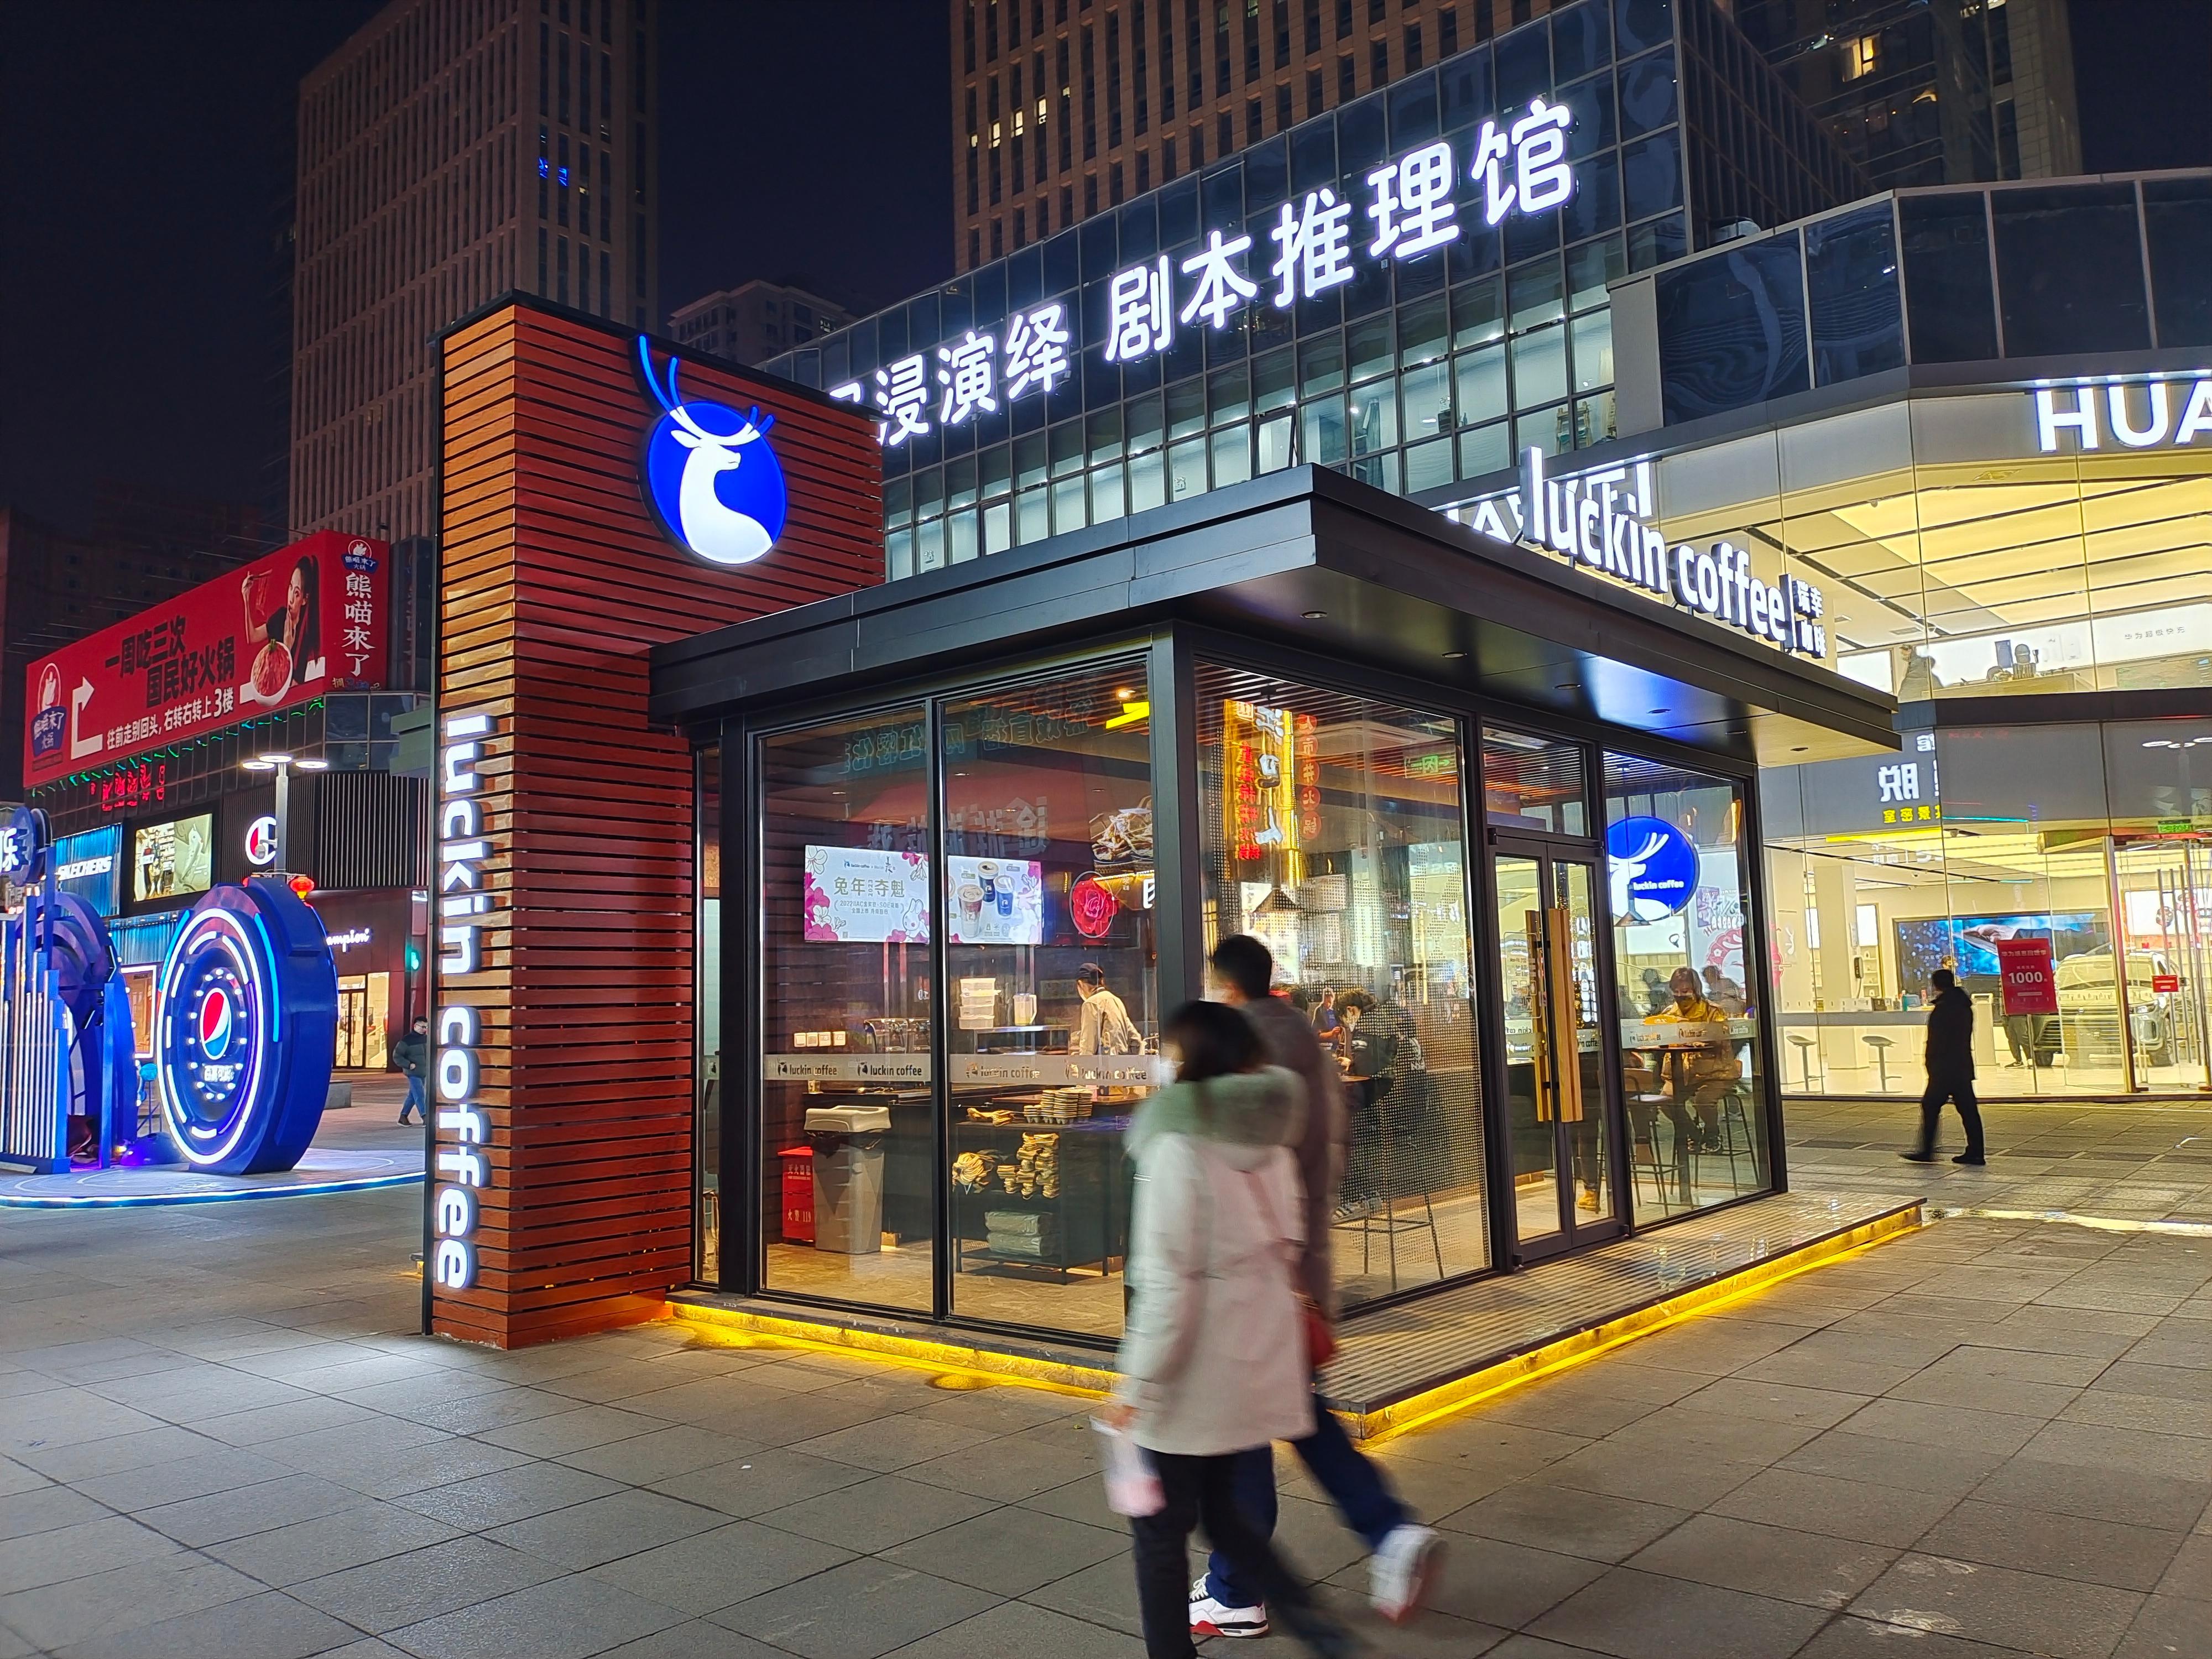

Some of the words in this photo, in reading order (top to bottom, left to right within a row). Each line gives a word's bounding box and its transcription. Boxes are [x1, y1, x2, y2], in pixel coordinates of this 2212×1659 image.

[830, 304, 1070, 446] 浸演绎
[1104, 98, 1573, 363] 剧本推理馆
[1521, 446, 1668, 594] luckin
[1673, 542, 1786, 643] coffee
[1793, 579, 1823, 618] 瑞幸
[341, 572, 376, 677] 熊喵來了
[1796, 618, 1826, 659] 咖啡
[105, 614, 186, 679] 一周吃三次
[146, 635, 235, 708] 国民好火锅
[0, 828, 19, 873] 乐
[443, 714, 489, 975] luckin
[56, 855, 112, 881] SKECHERS
[834, 876, 865, 896] 兔年
[874, 879, 905, 898] 夺魁
[1633, 881, 1657, 891] luckin
[1658, 879, 1684, 889] coffee
[2008, 971, 2043, 984] 1000
[790, 1063, 812, 1076] luckin
[814, 1064, 837, 1076] coffee
[870, 1064, 894, 1076] luckin
[896, 1065, 922, 1076] coffee
[437, 1004, 485, 1290] coffee
